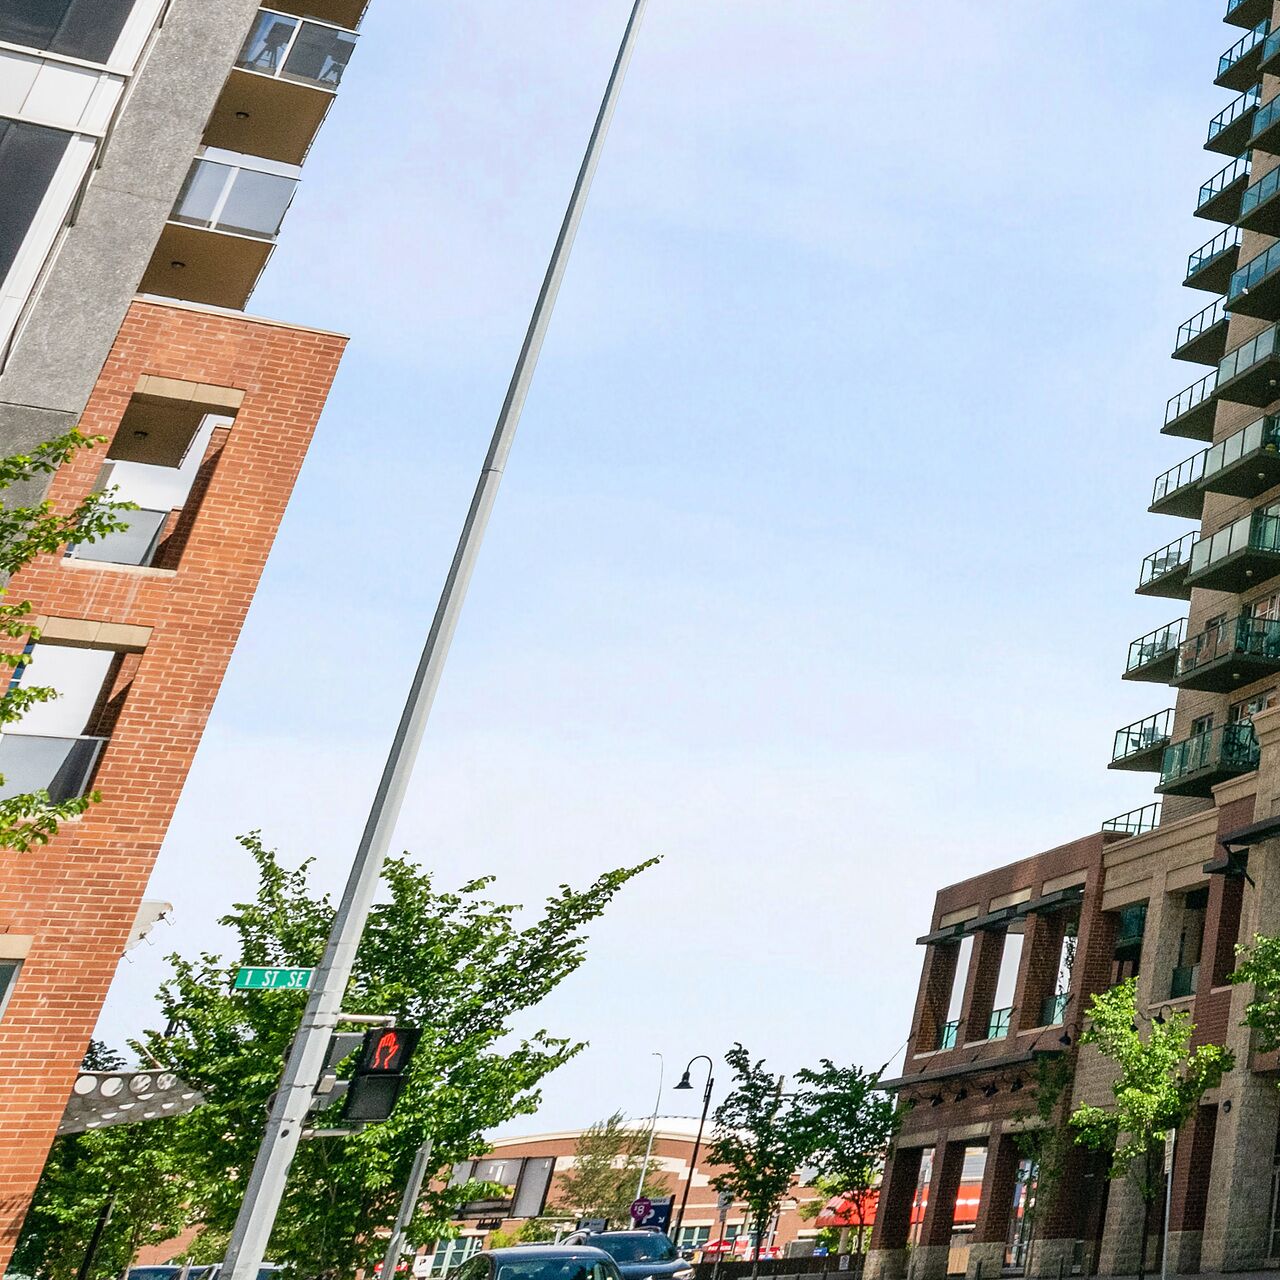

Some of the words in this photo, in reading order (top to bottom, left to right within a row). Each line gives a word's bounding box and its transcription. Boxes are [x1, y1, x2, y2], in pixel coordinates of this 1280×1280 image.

[245, 970, 253, 986] 1
[261, 971, 280, 986] ST
[287, 971, 305, 987] SE
